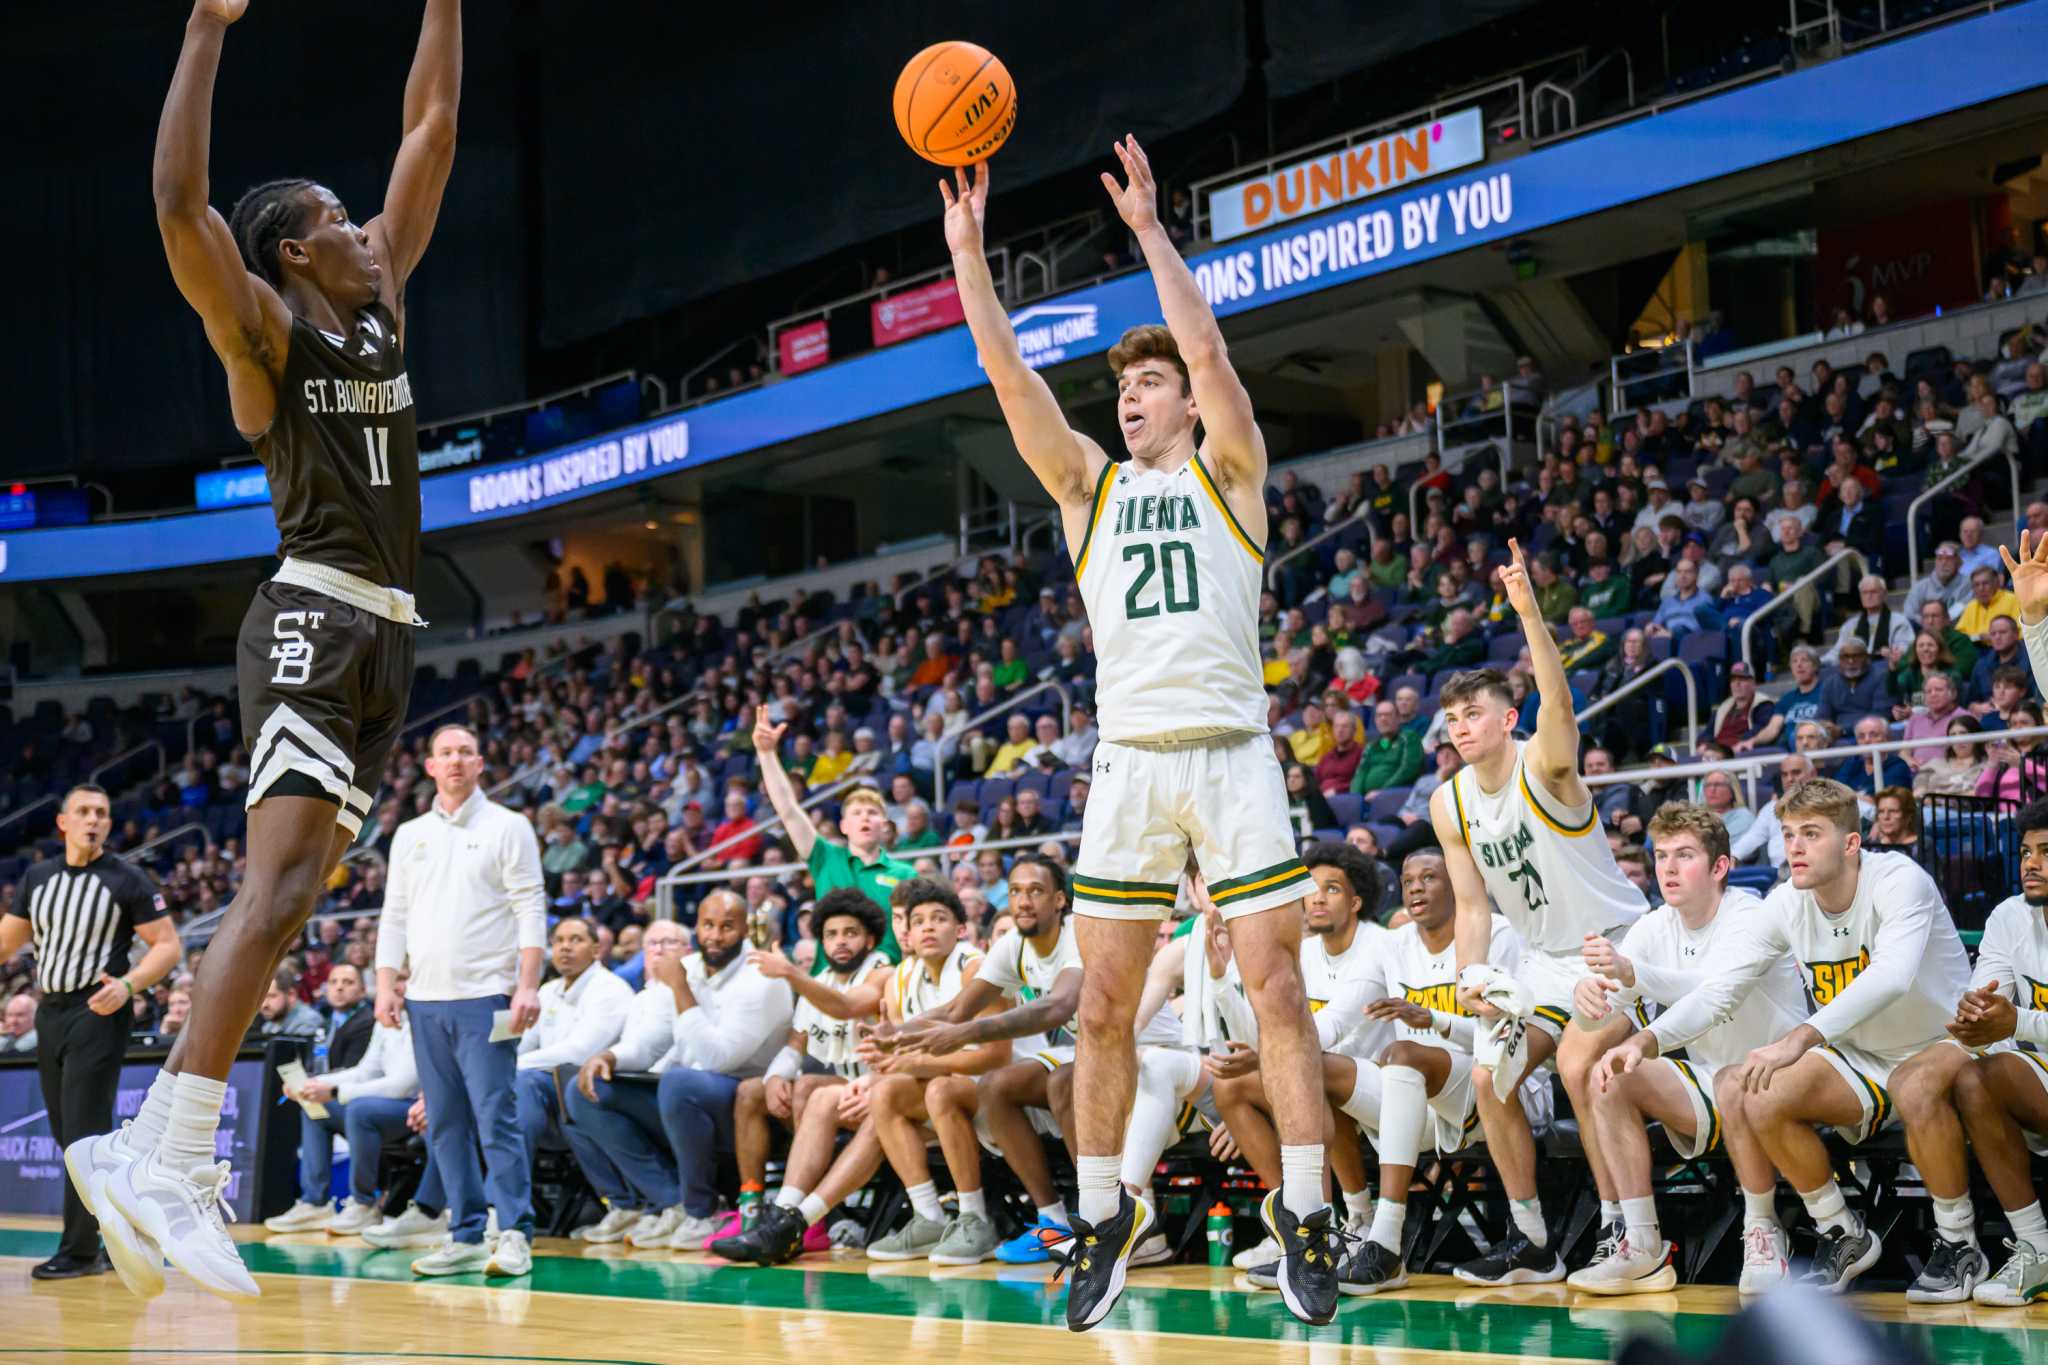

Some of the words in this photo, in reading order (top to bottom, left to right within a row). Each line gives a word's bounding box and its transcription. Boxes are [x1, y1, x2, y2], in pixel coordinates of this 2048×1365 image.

[1242, 122, 1442, 227] DUNKIN'
[1195, 251, 1256, 305] OMS
[1261, 209, 1395, 291] INSPIRED
[1401, 193, 1442, 251] BY
[1447, 172, 1513, 236] YOU
[1052, 313, 1098, 347] HOME
[363, 427, 391, 486] 11
[469, 463, 544, 513] ROOMS
[542, 440, 622, 497] INSPIRED
[621, 432, 649, 475] BY
[648, 420, 689, 466] YOU
[1122, 540, 1200, 620] 20
